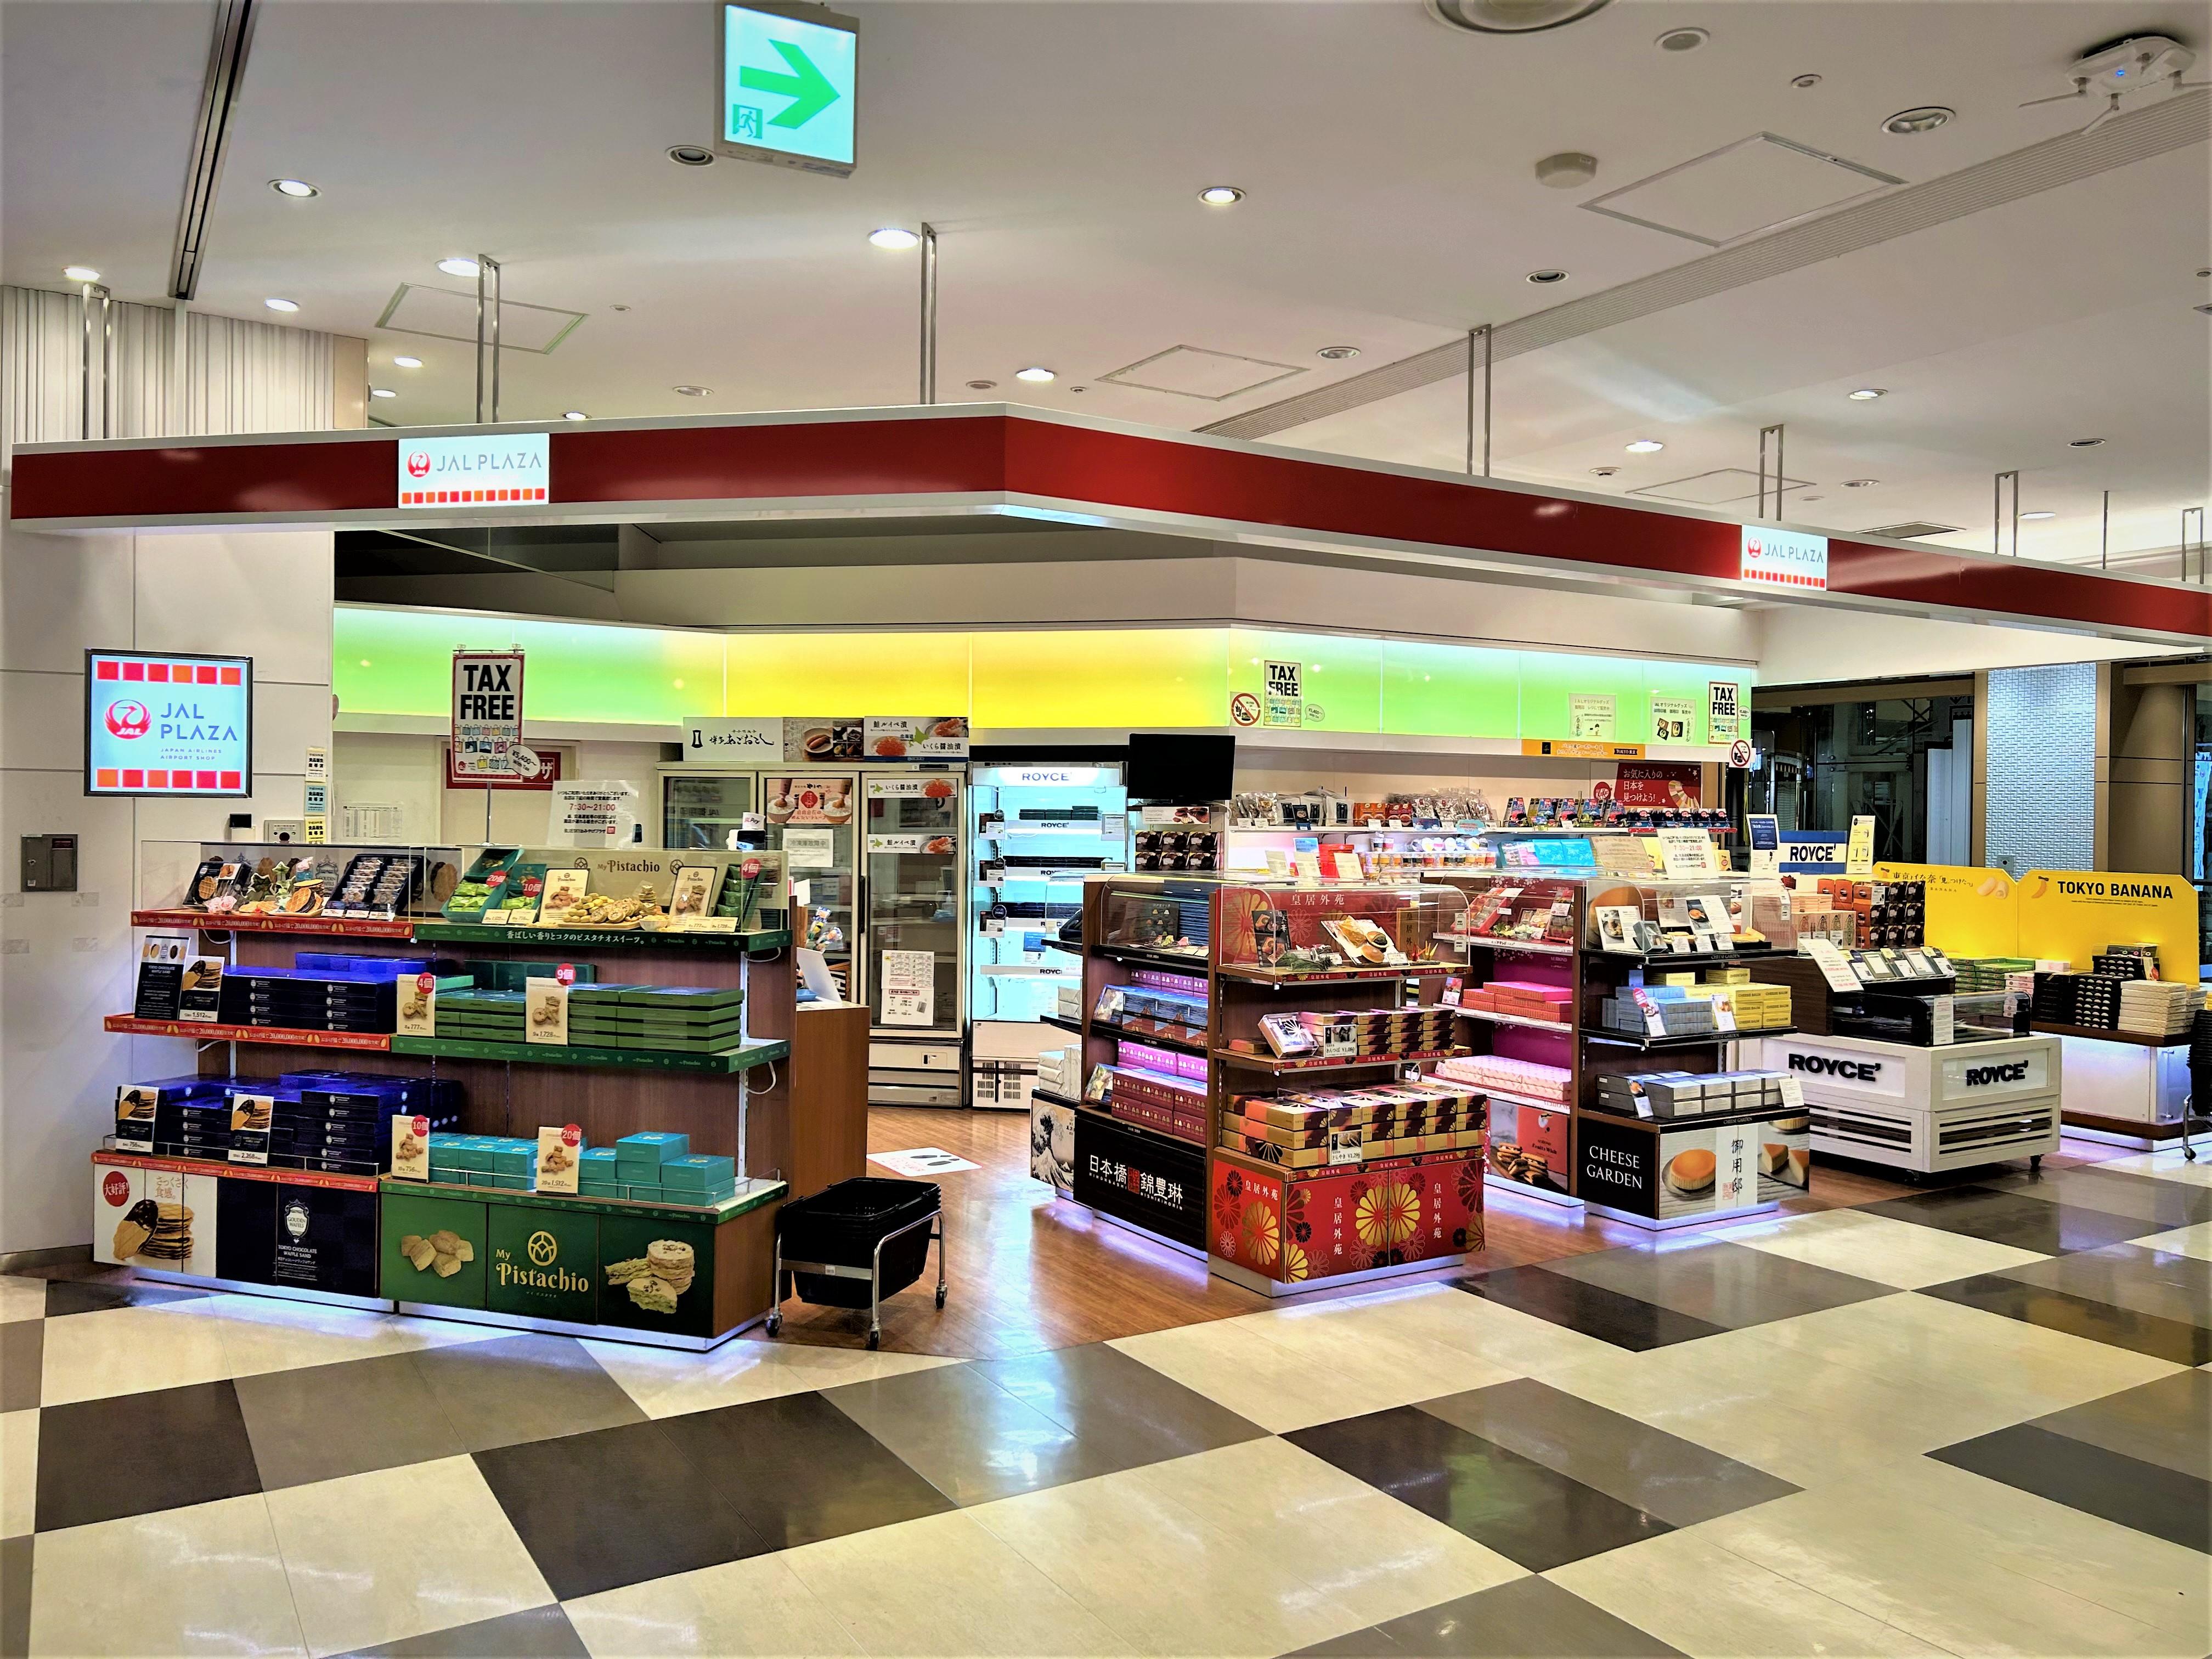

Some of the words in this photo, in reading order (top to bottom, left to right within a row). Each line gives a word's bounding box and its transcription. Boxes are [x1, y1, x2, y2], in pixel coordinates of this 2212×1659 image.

[437, 454, 472, 472] JAL
[478, 452, 542, 470] PLAZA
[1765, 543, 1785, 558] JAL
[1788, 546, 1824, 563] PLAZA
[463, 664, 511, 692] TAX
[1269, 665, 1296, 681] TAX
[1268, 681, 1298, 697] FREE
[1713, 686, 1734, 701] TAX
[160, 703, 205, 719] JAL
[460, 695, 514, 720] FREE
[1712, 702, 1735, 716] FREE
[160, 724, 238, 741] PLAZA
[1623, 768, 1663, 779] お気に入りの
[1623, 780, 1644, 791] 日本を
[1623, 792, 1656, 803] 見つけよう!
[1790, 843, 1836, 862] ROYCE'
[607, 860, 660, 872] Pistachio
[742, 863, 759, 873] 4個
[487, 874, 506, 883] 20個
[523, 883, 542, 892] 10個
[2057, 881, 2104, 895] TOKYO
[2111, 883, 2173, 899] BANANA
[1290, 894, 1345, 906] 皇居外苑
[506, 930, 645, 945] 香ばしい香りとコクのピスタチオスイーツ。
[557, 969, 574, 980] 9個
[418, 979, 432, 988] 4個
[1788, 1053, 1881, 1082] ROYCE'
[1966, 1060, 2029, 1087] ROYCE'
[413, 1121, 428, 1131] 10個
[562, 1130, 580, 1141] 20個
[1589, 1146, 1640, 1169] CHEESE
[1731, 1138, 1743, 1194] 御用邸
[156, 1176, 189, 1189] さっくさく
[1090, 1155, 1127, 1184] 日本橋
[1140, 1172, 1183, 1204] 錦豊琳
[1587, 1164, 1642, 1189] GARDEN
[104, 1182, 129, 1197] 大好評!
[155, 1187, 176, 1199] 食感。
[1244, 1180, 1279, 1201] 皇居外苑
[1432, 1182, 1442, 1239] 皇居外苑
[1333, 1197, 1344, 1256] 皇居外苑
[495, 1248, 511, 1261] My
[495, 1262, 589, 1293] Pistachio
